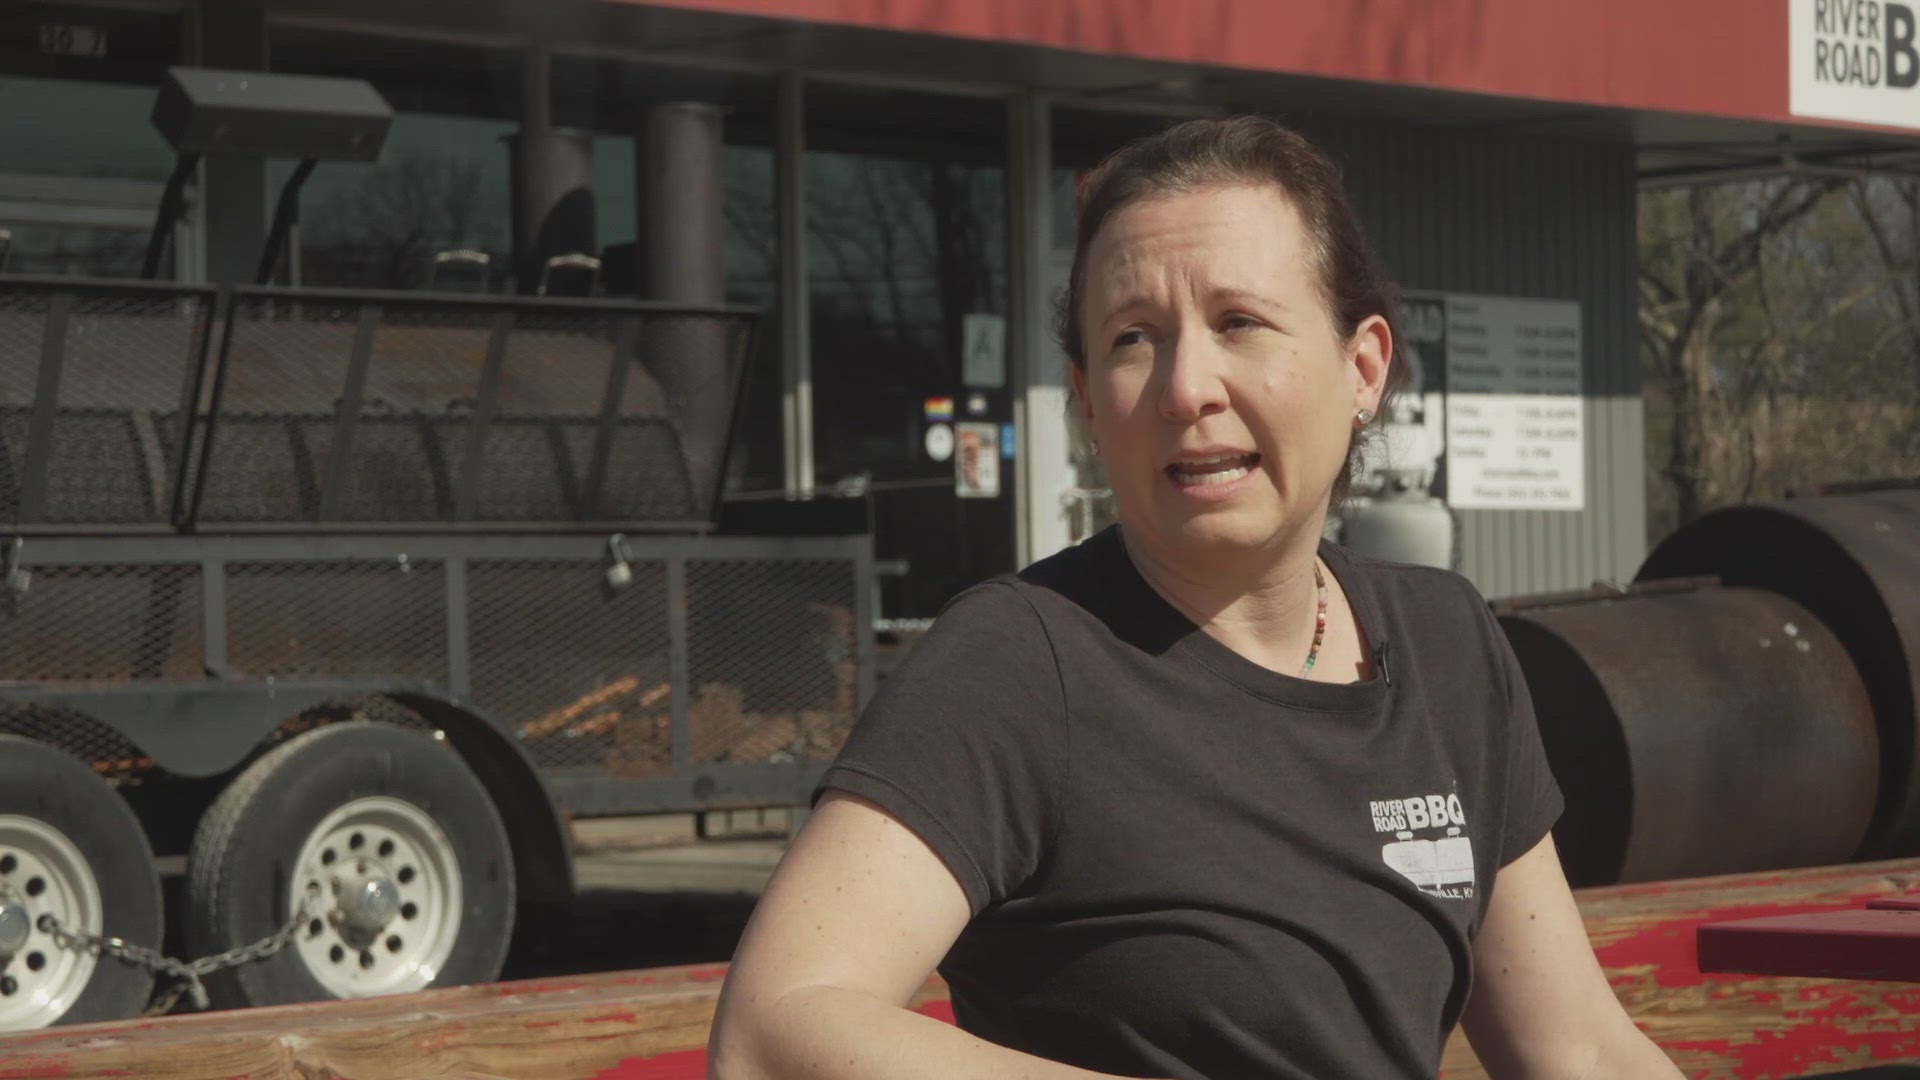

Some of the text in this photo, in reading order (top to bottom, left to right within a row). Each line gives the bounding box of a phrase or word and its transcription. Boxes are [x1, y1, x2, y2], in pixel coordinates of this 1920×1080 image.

[1815, 0, 1880, 39] RIVER
[1815, 39, 1881, 86] ROAD
[1370, 799, 1406, 817] RIVER
[1374, 815, 1408, 832] ROAD
[1403, 793, 1466, 830] BBQ
